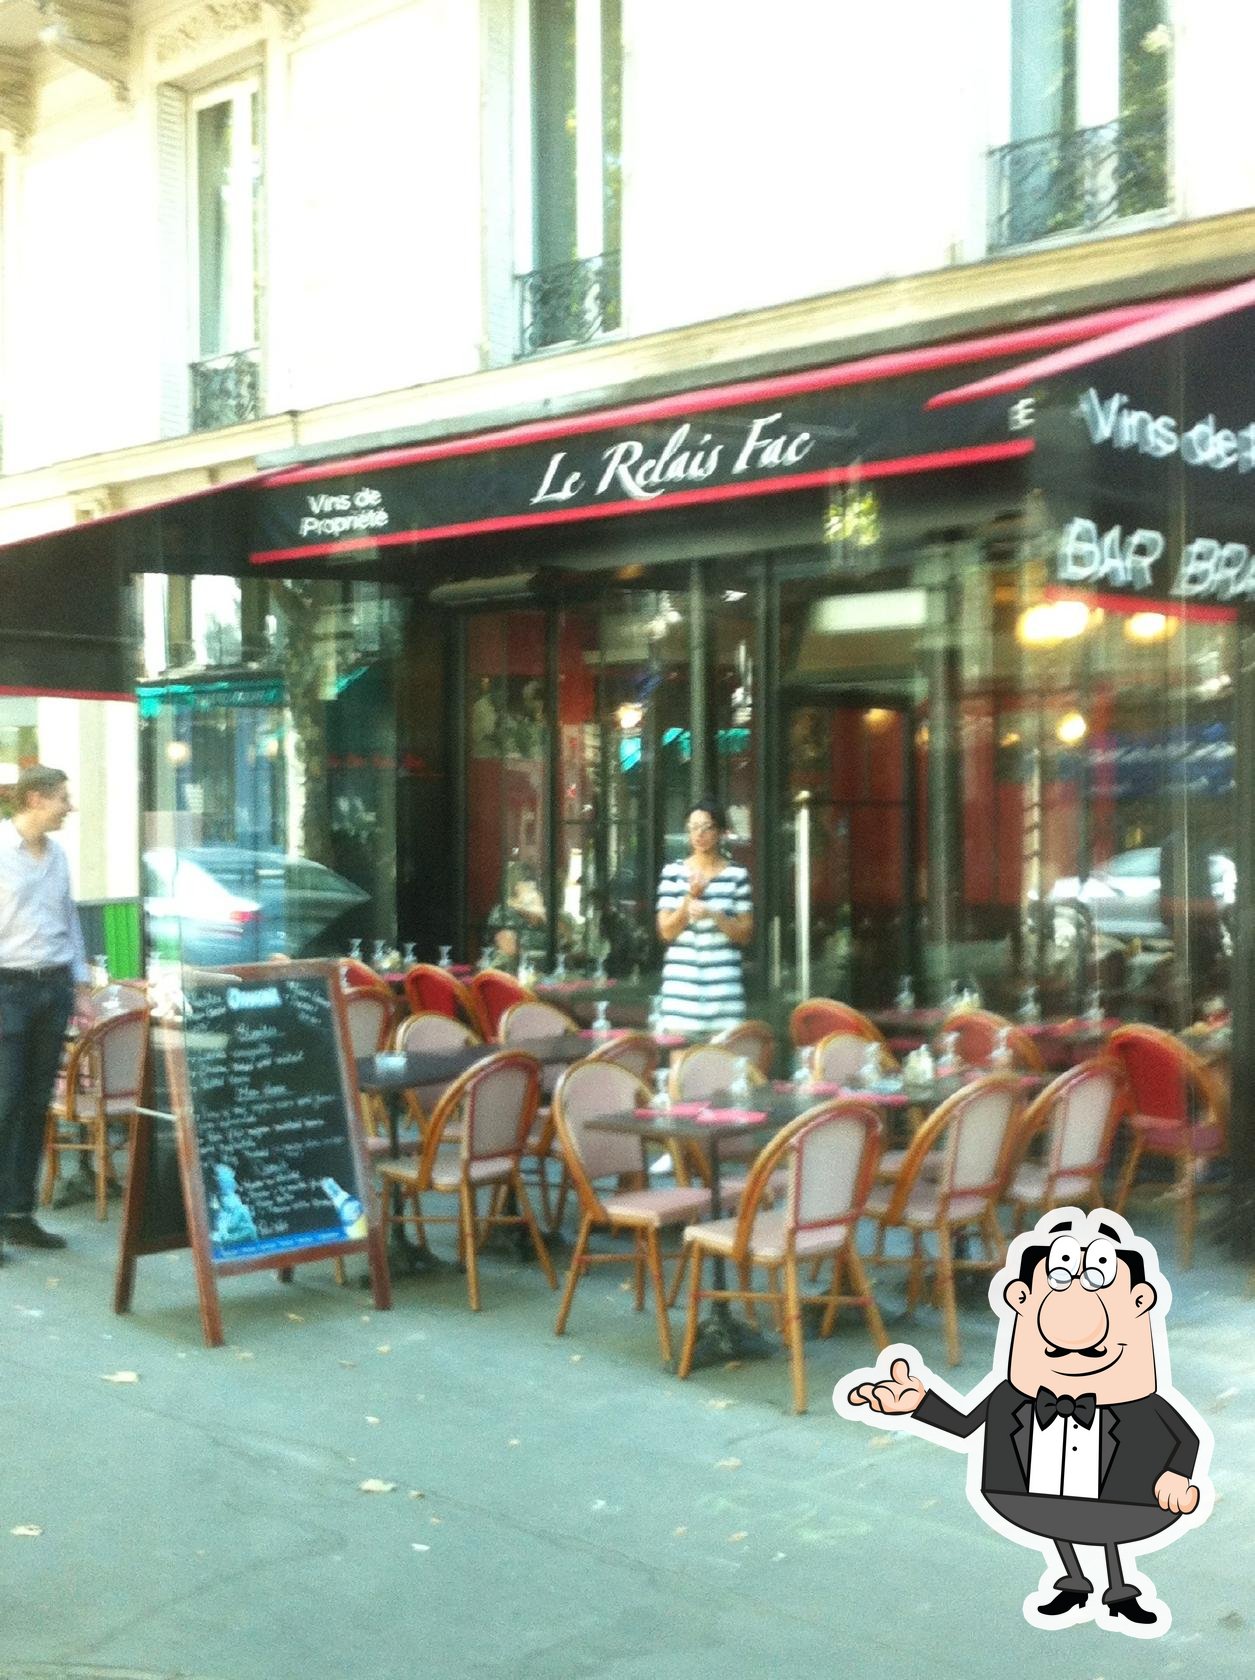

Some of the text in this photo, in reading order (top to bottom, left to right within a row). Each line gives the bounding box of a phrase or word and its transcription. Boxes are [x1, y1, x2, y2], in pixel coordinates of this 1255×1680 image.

[529, 412, 815, 505] Le Relais Fac
[1075, 387, 1179, 457] Vins
[1180, 413, 1238, 469] de
[306, 487, 382, 515] Vins de
[1057, 516, 1165, 591] BAR
